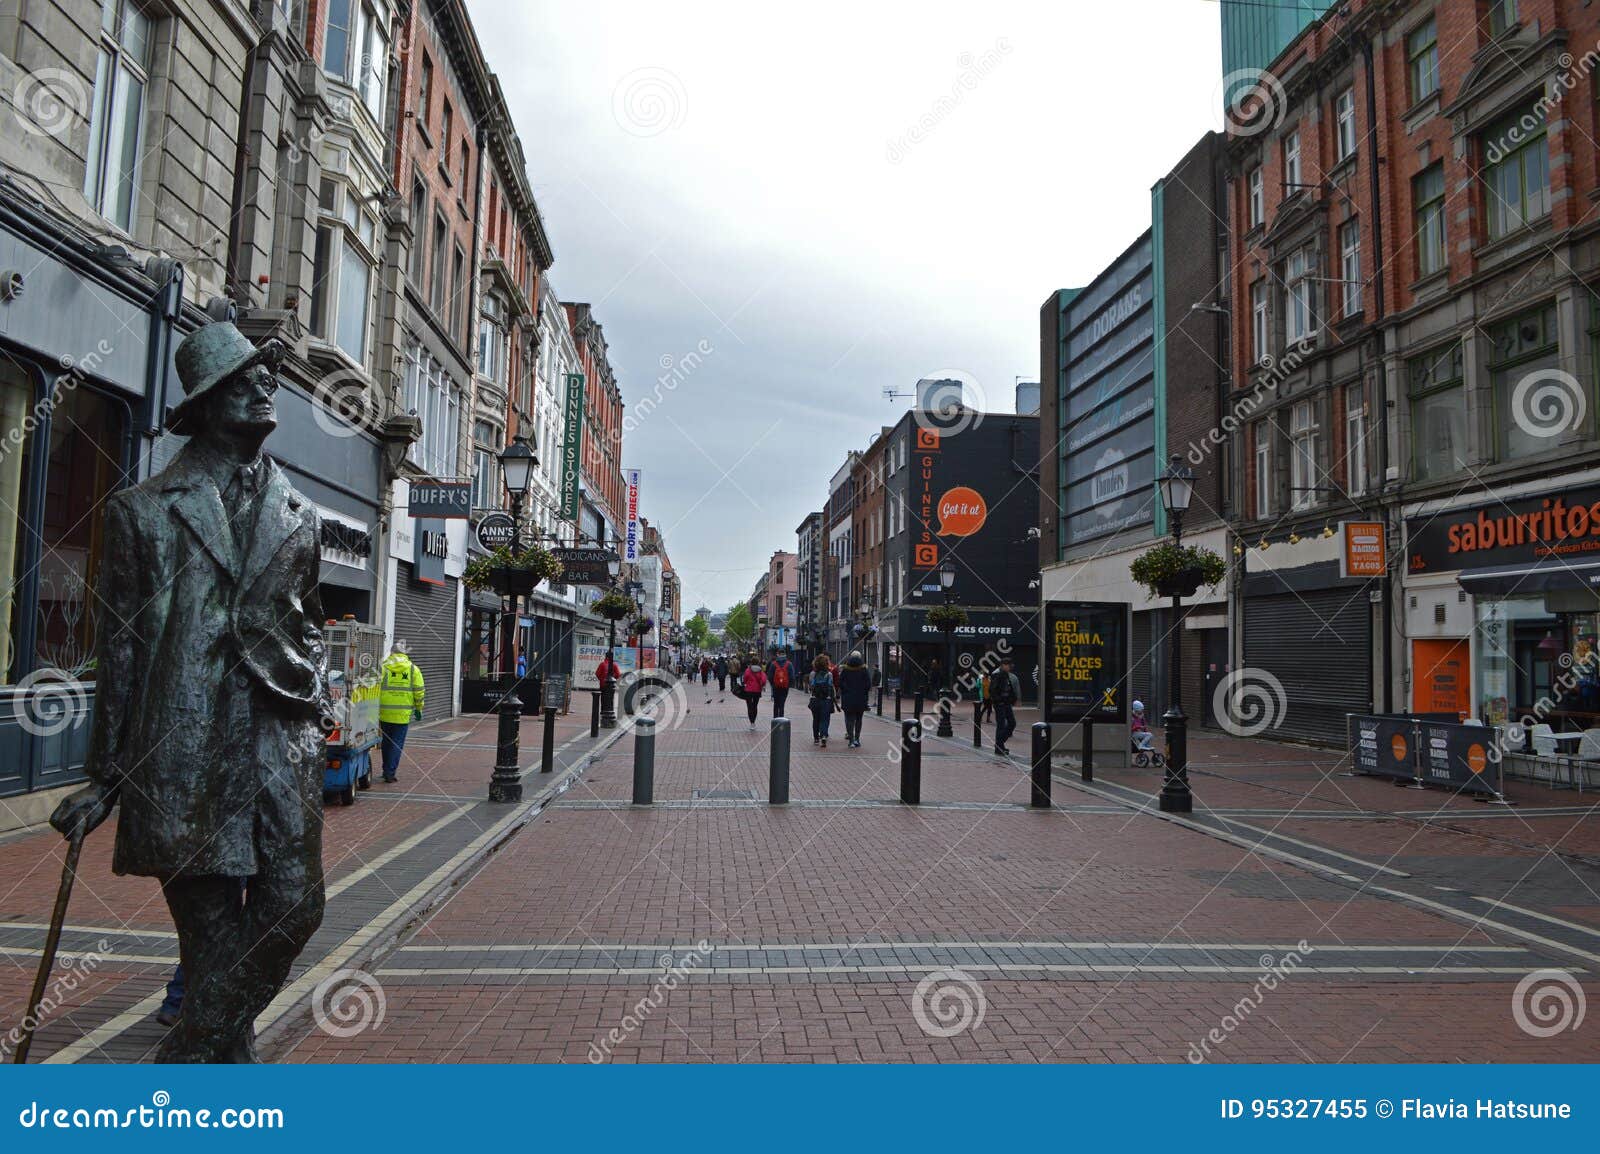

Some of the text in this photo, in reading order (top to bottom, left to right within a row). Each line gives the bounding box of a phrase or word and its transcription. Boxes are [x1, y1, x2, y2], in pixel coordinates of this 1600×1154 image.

[563, 377, 581, 516] DUNNES STORES
[411, 488, 468, 504] DUFFY'S
[920, 456, 932, 543] GUINEYS
[943, 503, 980, 519] Get it at
[480, 526, 514, 537] ANN'S
[627, 521, 636, 559] SPORTS
[1353, 561, 1381, 570] TACOS
[568, 571, 589, 581] BAR
[922, 625, 1012, 635] STAUCKS COFFEE
[1055, 621, 1078, 633] GET
[1055, 633, 1090, 645] FROM
[1055, 657, 1102, 669] PLACES
